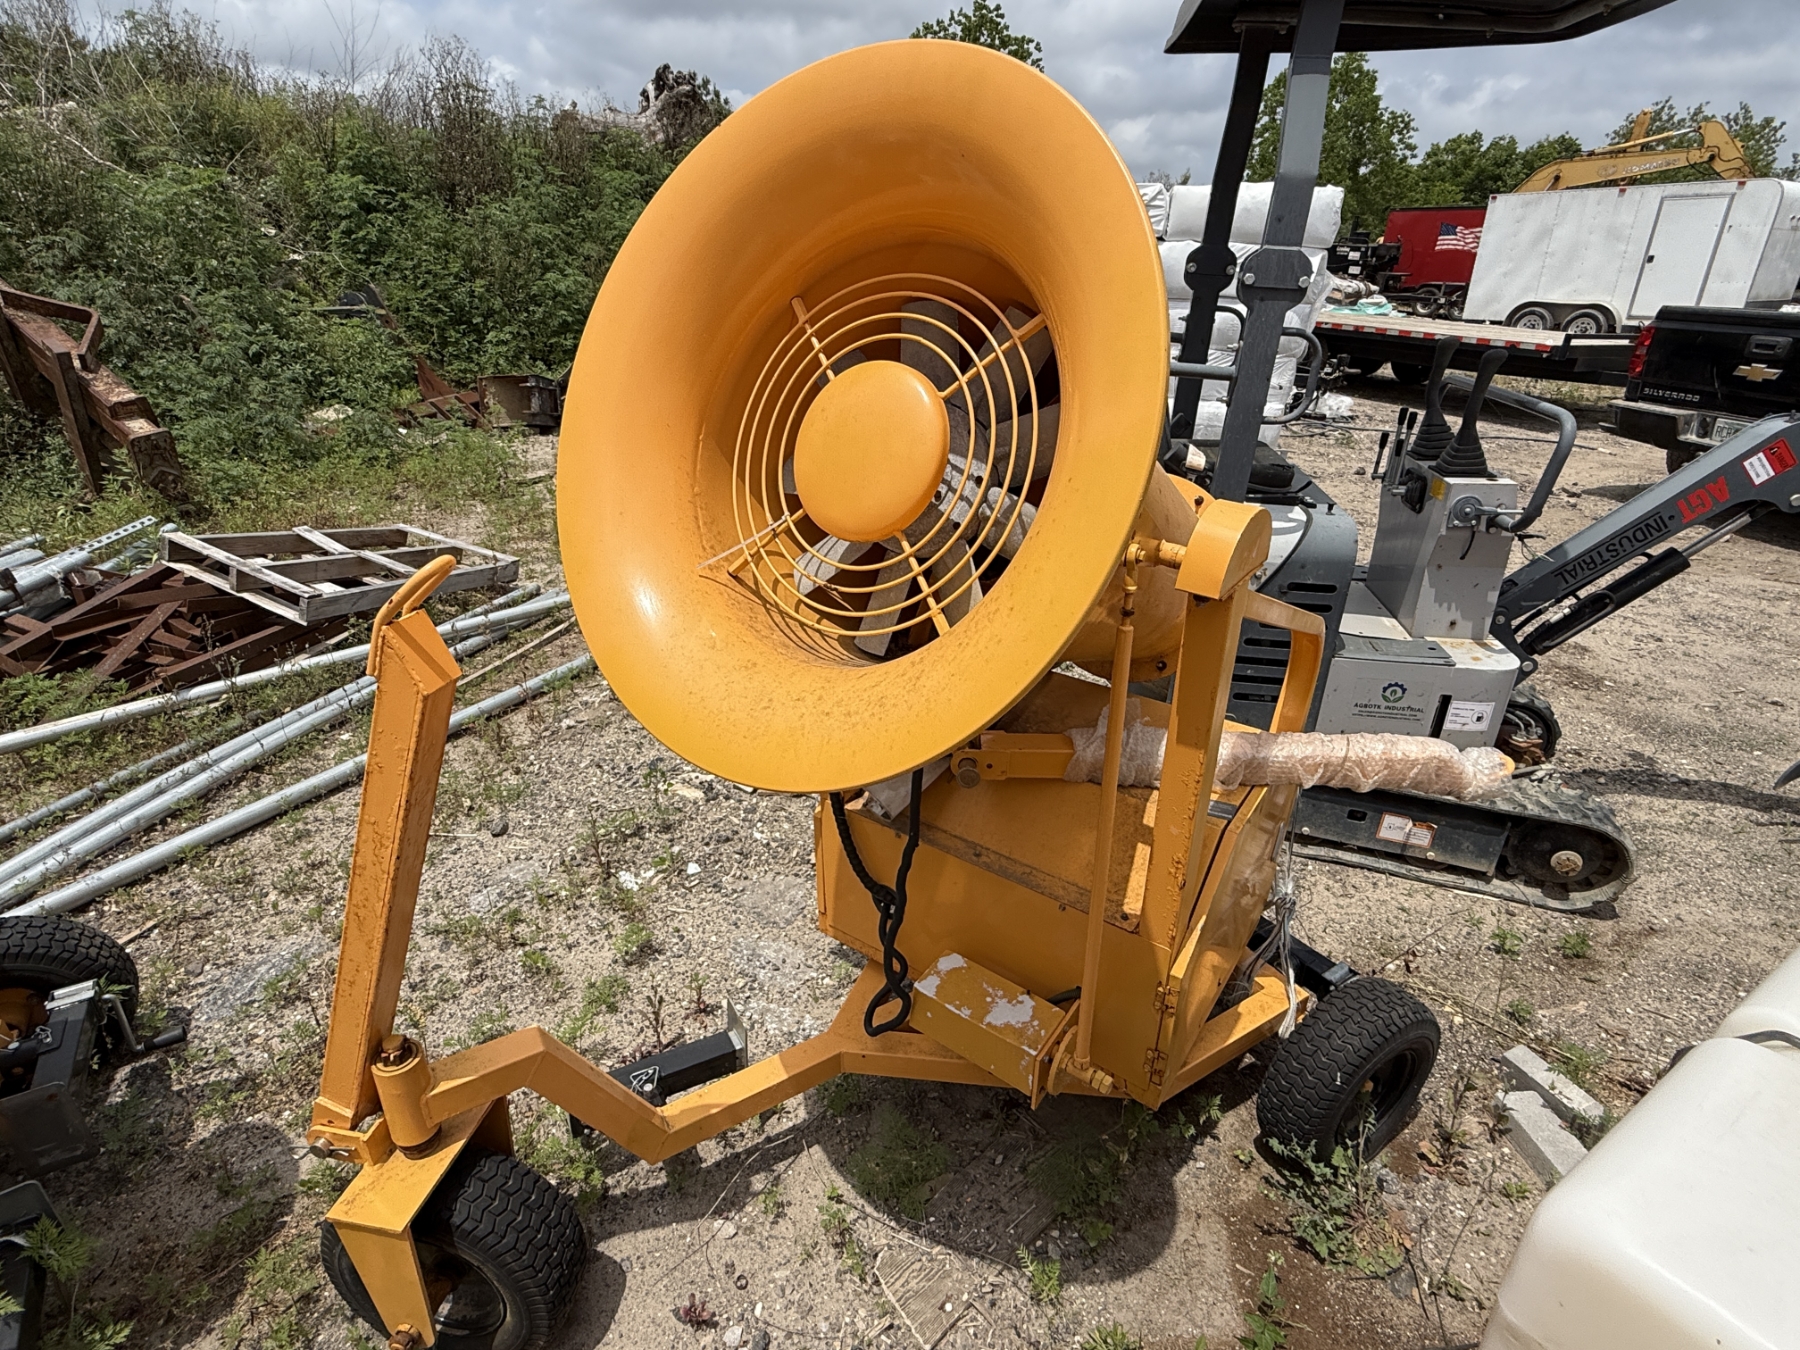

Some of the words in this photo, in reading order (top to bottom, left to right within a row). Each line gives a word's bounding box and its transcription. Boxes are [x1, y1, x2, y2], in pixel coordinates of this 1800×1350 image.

[1643, 388, 1700, 402] SILVERADO
[1676, 475, 1730, 524] AGT
[1554, 515, 1669, 585] INDUSTRIAL
[1384, 704, 1424, 713] INDUSTRIAL
